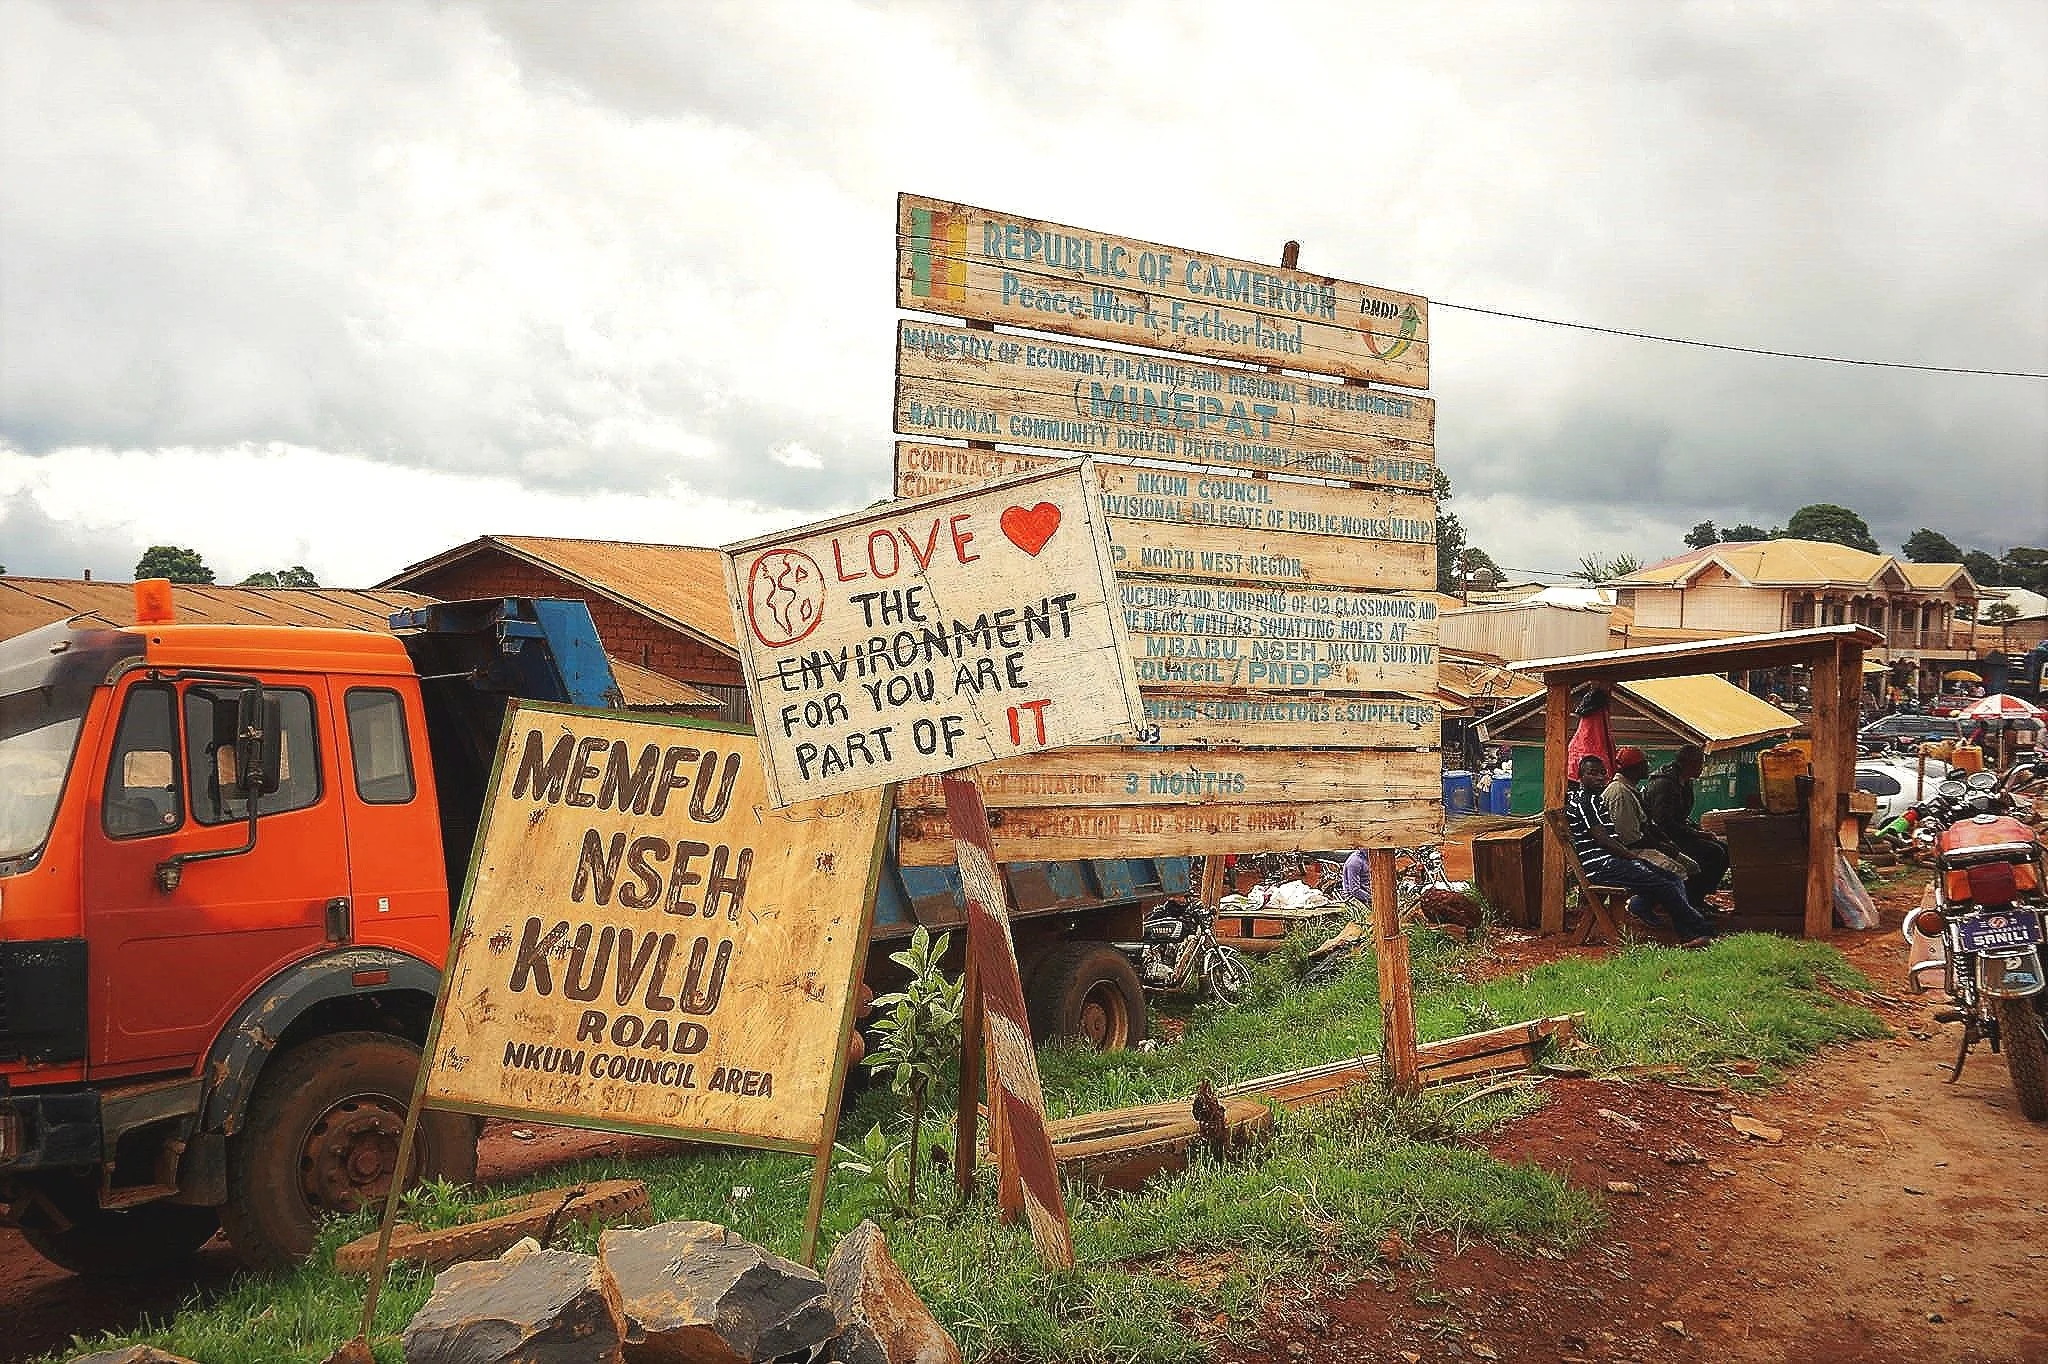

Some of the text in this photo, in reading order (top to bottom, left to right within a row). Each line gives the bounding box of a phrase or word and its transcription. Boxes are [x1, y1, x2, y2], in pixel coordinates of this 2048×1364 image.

[983, 220, 1337, 320] REPUBLIC OF CAMEROON
[903, 327, 993, 361] MINISTRY
[998, 341, 1020, 364] OF
[1191, 368, 1223, 392] AND
[1228, 374, 1300, 404] REGIONAL
[1307, 386, 1414, 418] DEVELOPMENT
[909, 401, 1002, 434] NATIONAL
[1009, 415, 1110, 447] COMMUNITY
[1117, 427, 1177, 454] DRIVEN
[1182, 436, 1289, 468] DEVELOPMENT
[907, 447, 1007, 477] CONTRACT
[1136, 473, 1273, 505] NKUM COUNCIL
[1191, 502, 1263, 528] DELEGATE
[1266, 508, 1284, 530] OF
[1287, 510, 1338, 534] PUBLIC
[1340, 515, 1386, 538] WORKS
[831, 513, 981, 582] LOVE
[1140, 547, 1195, 569] NORTH
[1200, 551, 1243, 574] WEST
[1248, 555, 1302, 578] REGION
[850, 585, 928, 627] THE
[1143, 611, 1188, 633] BLOCK
[1193, 613, 1228, 634] WITH
[1259, 617, 1335, 640] SQUATTING
[1340, 620, 1383, 642] HOLES
[1389, 623, 1408, 642] AT
[1184, 589, 1212, 609] AND
[1217, 590, 1287, 613] EQUIPPING
[1291, 596, 1307, 613] OF
[1335, 597, 1416, 619] CLASSROOMS
[1418, 603, 1437, 621] AND
[777, 592, 1077, 692] ENVIRONMENT
[1327, 642, 1378, 664] NKUM
[781, 651, 1030, 739] FOR YOU ARE
[1247, 661, 1331, 686] PNDP
[1204, 700, 1330, 722] CONTRACTORS
[1346, 703, 1434, 723] SUPPLIERS
[795, 698, 1053, 781] PART OF IT
[511, 729, 741, 824] MEMFU
[1125, 772, 1140, 796] 3
[1149, 770, 1246, 796] MONTHS
[1130, 813, 1163, 835] AND
[1175, 812, 1241, 832] SERVICE
[571, 828, 754, 922] NSEH
[509, 916, 733, 1016] KUVLU
[576, 1009, 710, 1055] ROAD
[502, 1040, 585, 1076] NKUM
[589, 1053, 696, 1089] COUNCIL
[707, 1066, 774, 1099] AREA
